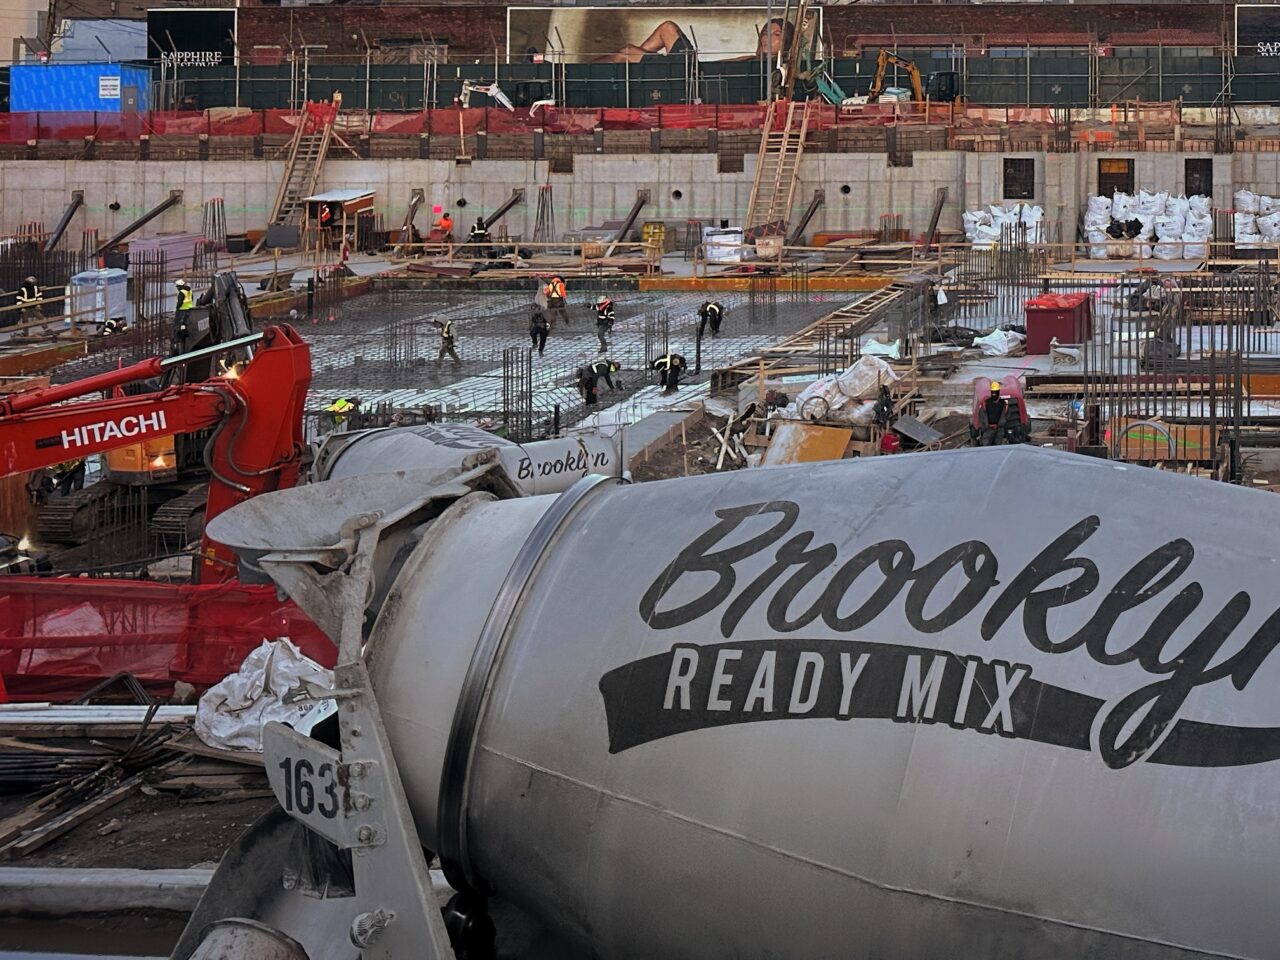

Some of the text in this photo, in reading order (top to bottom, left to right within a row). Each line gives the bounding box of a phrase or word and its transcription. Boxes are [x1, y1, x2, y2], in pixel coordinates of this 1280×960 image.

[161, 51, 222, 62] SAPPHIRE
[61, 410, 167, 449] HITACHI
[663, 647, 1026, 733] READY MIX
[279, 756, 340, 819] 163
